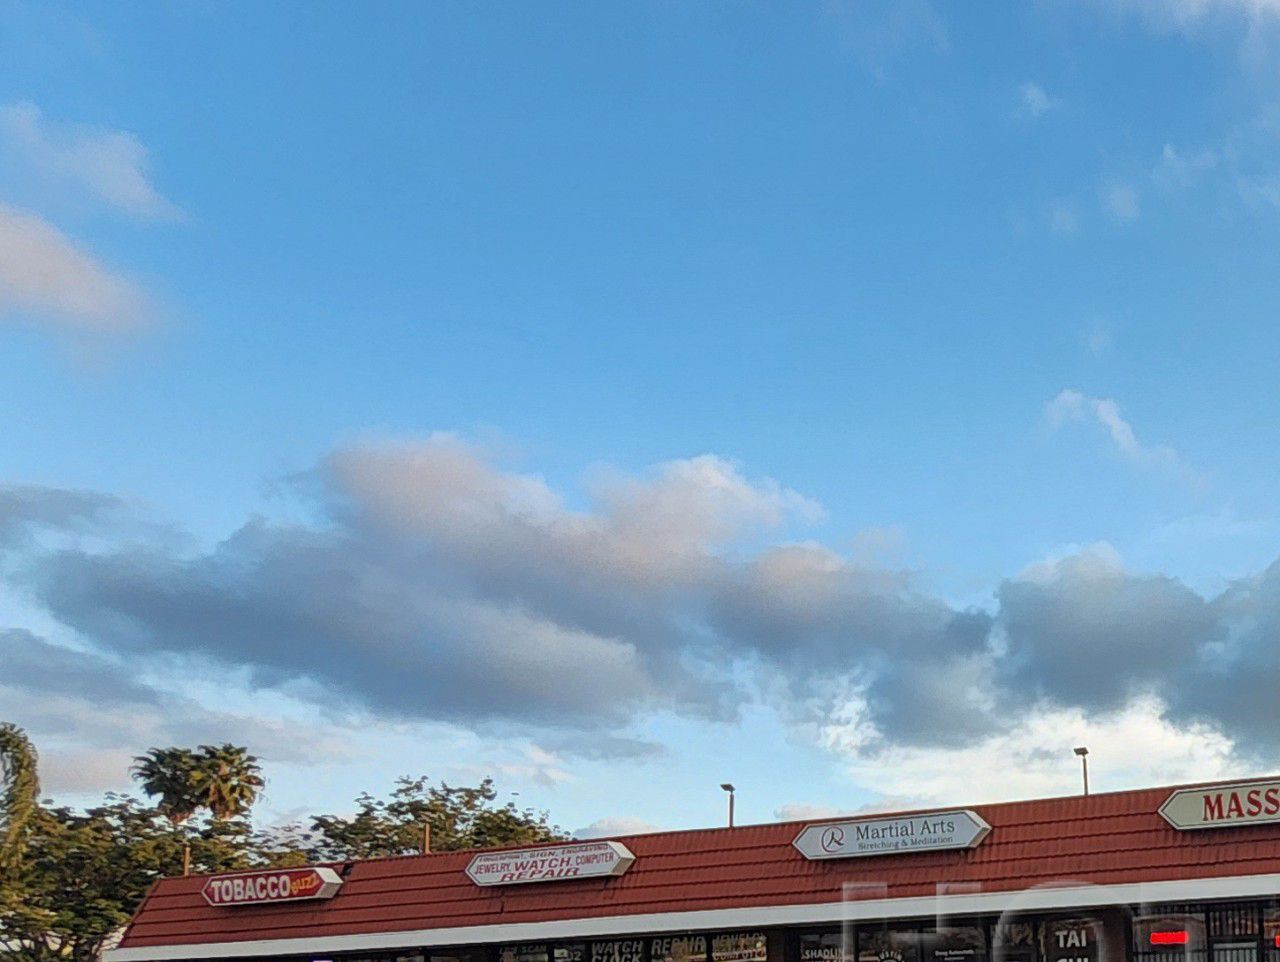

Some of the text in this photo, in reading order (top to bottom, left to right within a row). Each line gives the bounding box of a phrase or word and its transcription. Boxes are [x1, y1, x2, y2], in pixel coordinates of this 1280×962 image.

[856, 819, 955, 840] Martial Arts
[858, 840, 900, 851] Stretching
[910, 836, 953, 846] Meditation
[575, 852, 614, 866] COMPUTER
[500, 867, 580, 881] REPAIR
[211, 875, 291, 902] TOBACCO
[651, 936, 707, 955] REPAIR
[1055, 929, 1087, 948] TAI
[592, 941, 643, 955] WATCH
